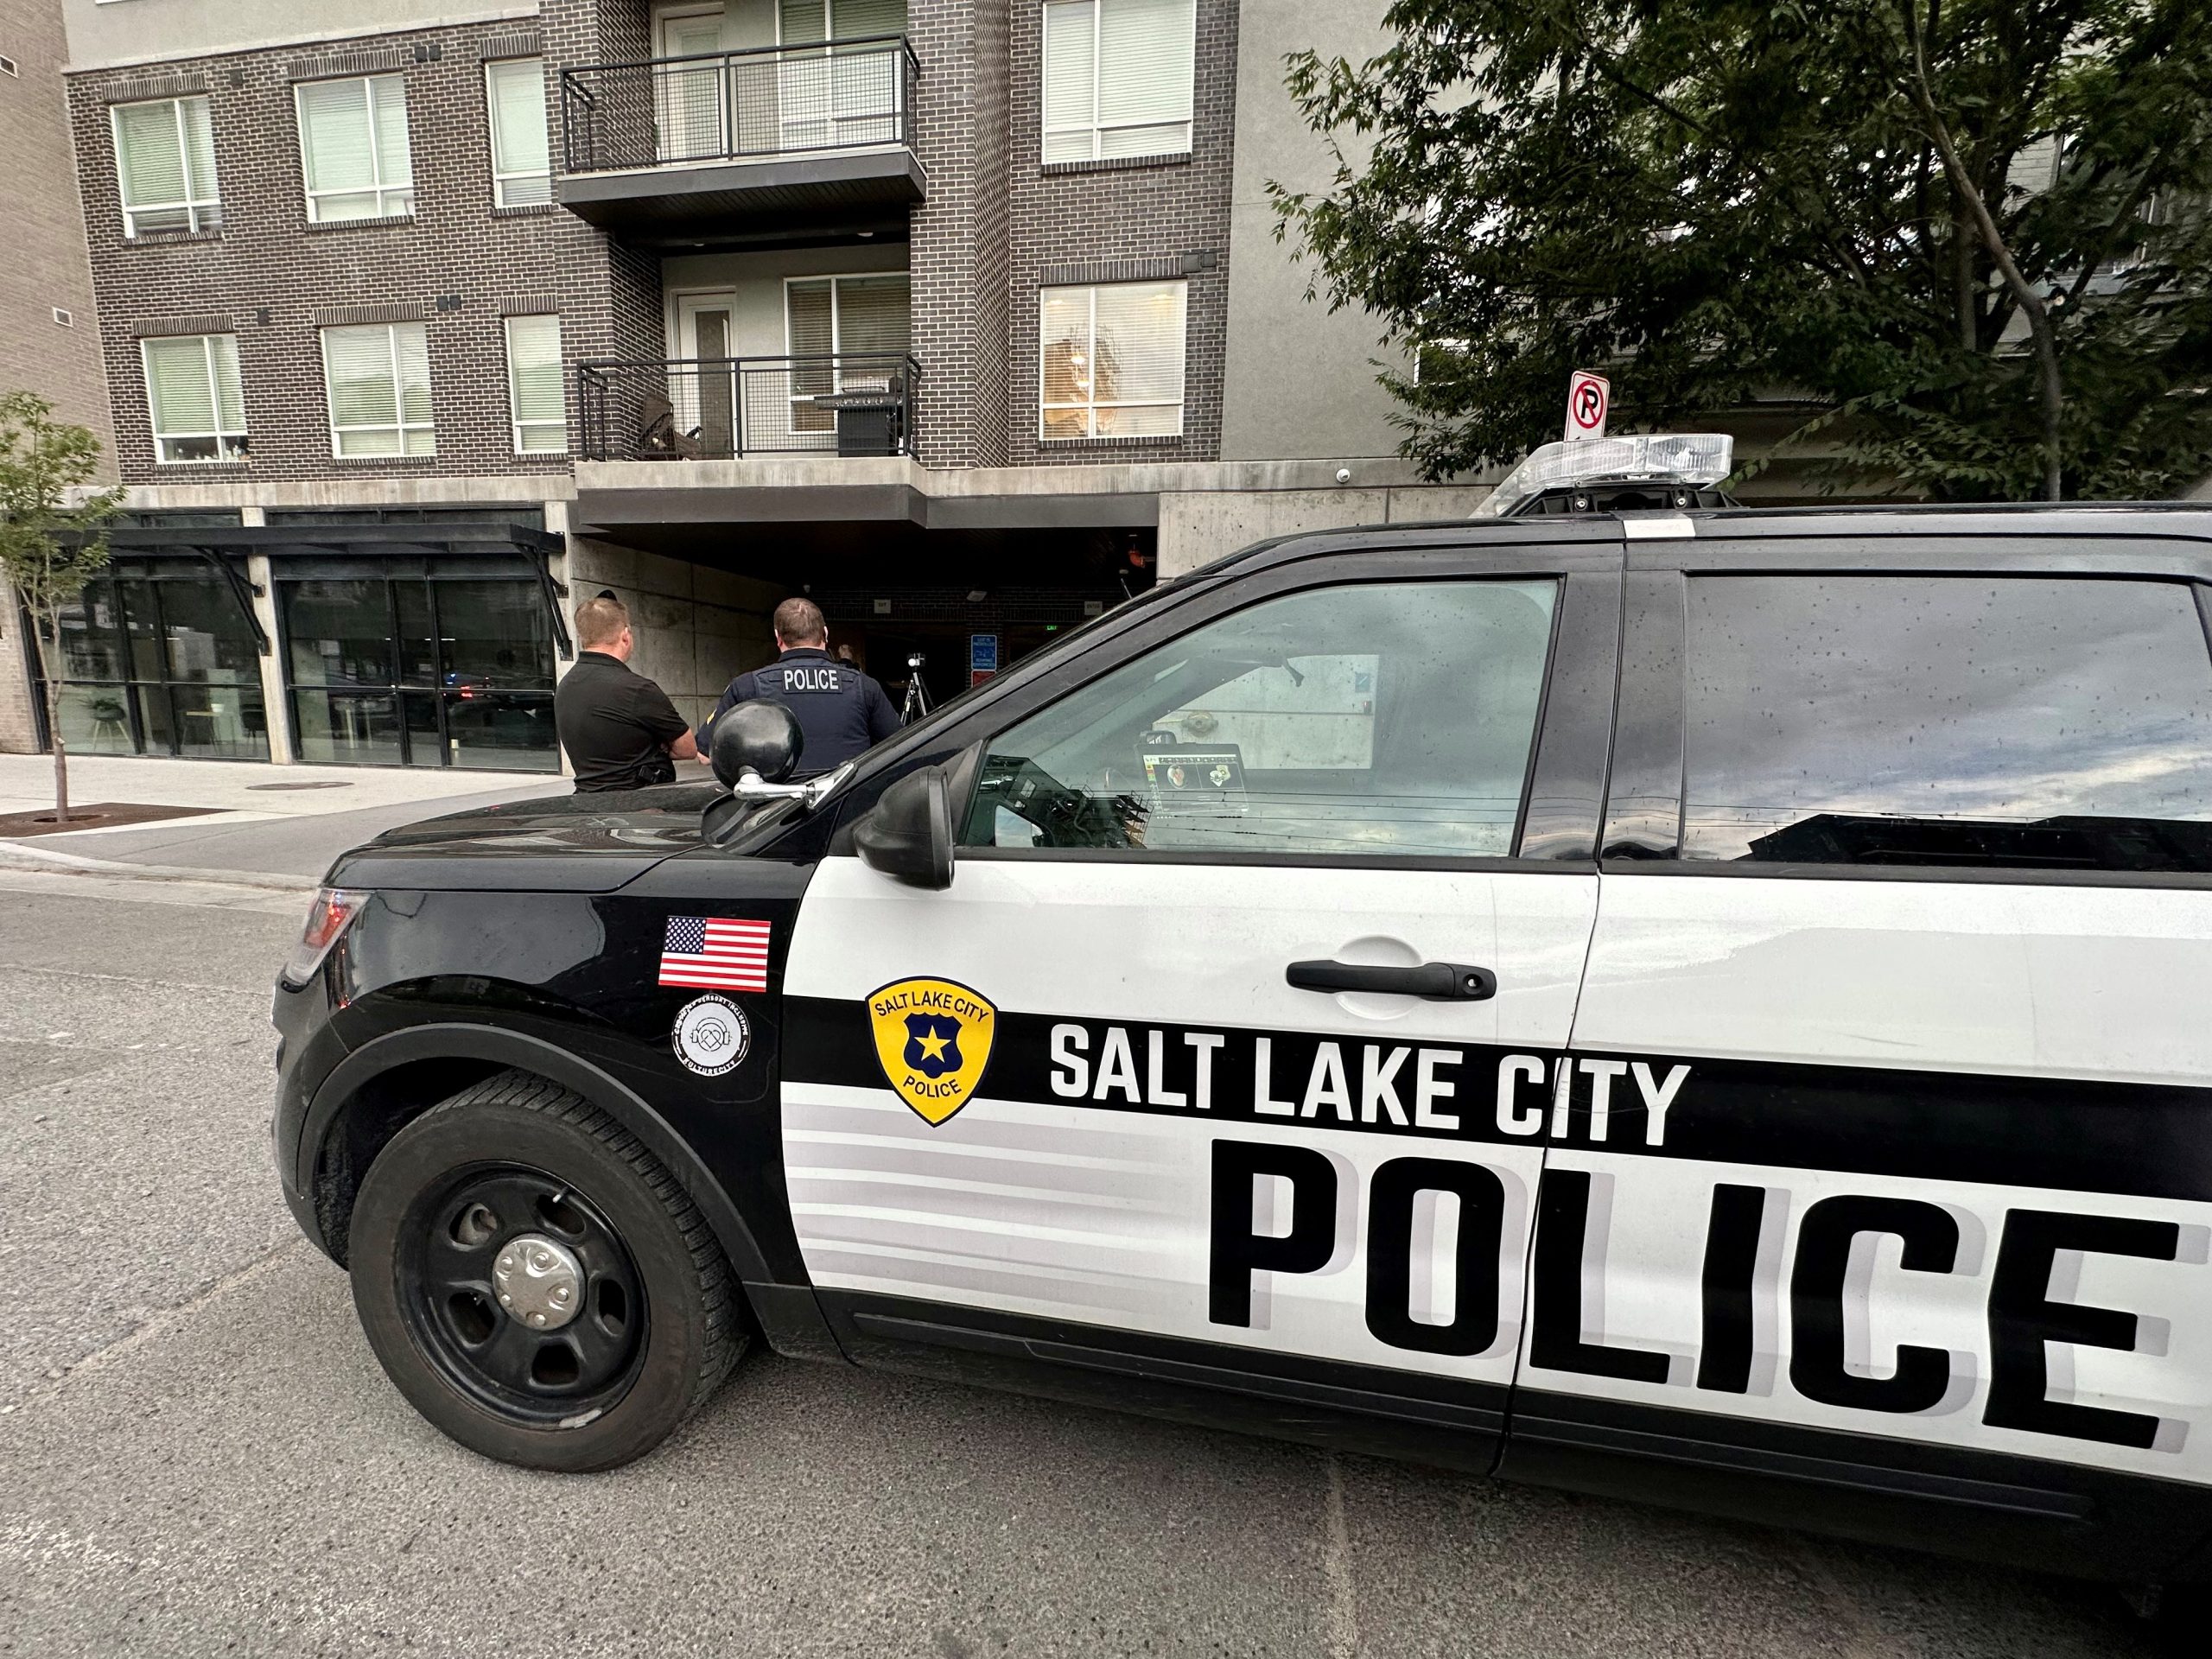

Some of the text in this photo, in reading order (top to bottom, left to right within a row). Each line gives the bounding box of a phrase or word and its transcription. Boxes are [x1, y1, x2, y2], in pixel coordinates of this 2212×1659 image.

[784, 669, 839, 690] POLICE
[874, 990, 989, 1023] SALT LAKE CITY
[683, 1057, 735, 1074] KULTURECITY
[903, 1075, 963, 1098] POLICE
[1051, 1023, 1692, 1147] SALT LAKE CITY
[1209, 1138, 2182, 1450] POLICE
